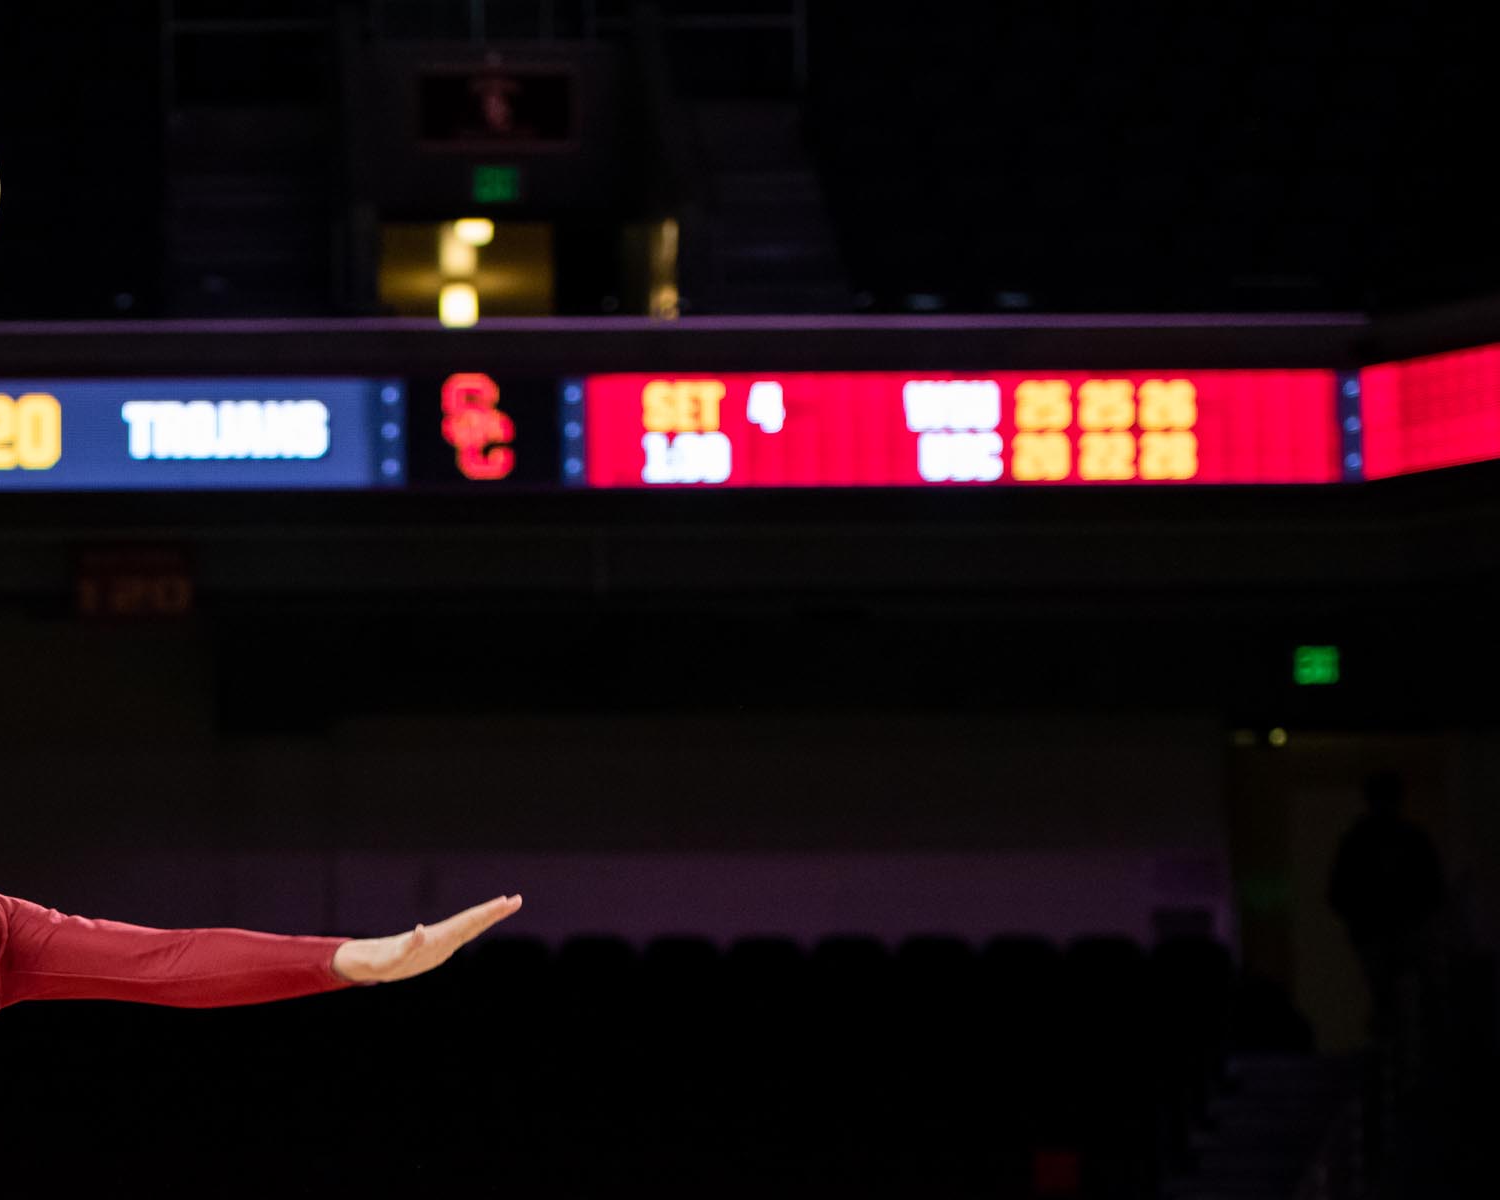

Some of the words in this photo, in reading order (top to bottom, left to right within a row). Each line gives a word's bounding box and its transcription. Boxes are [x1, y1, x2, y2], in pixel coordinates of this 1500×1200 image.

[122, 400, 330, 460] TROJANS
[641, 380, 726, 432] SET
[747, 381, 785, 433] 4
